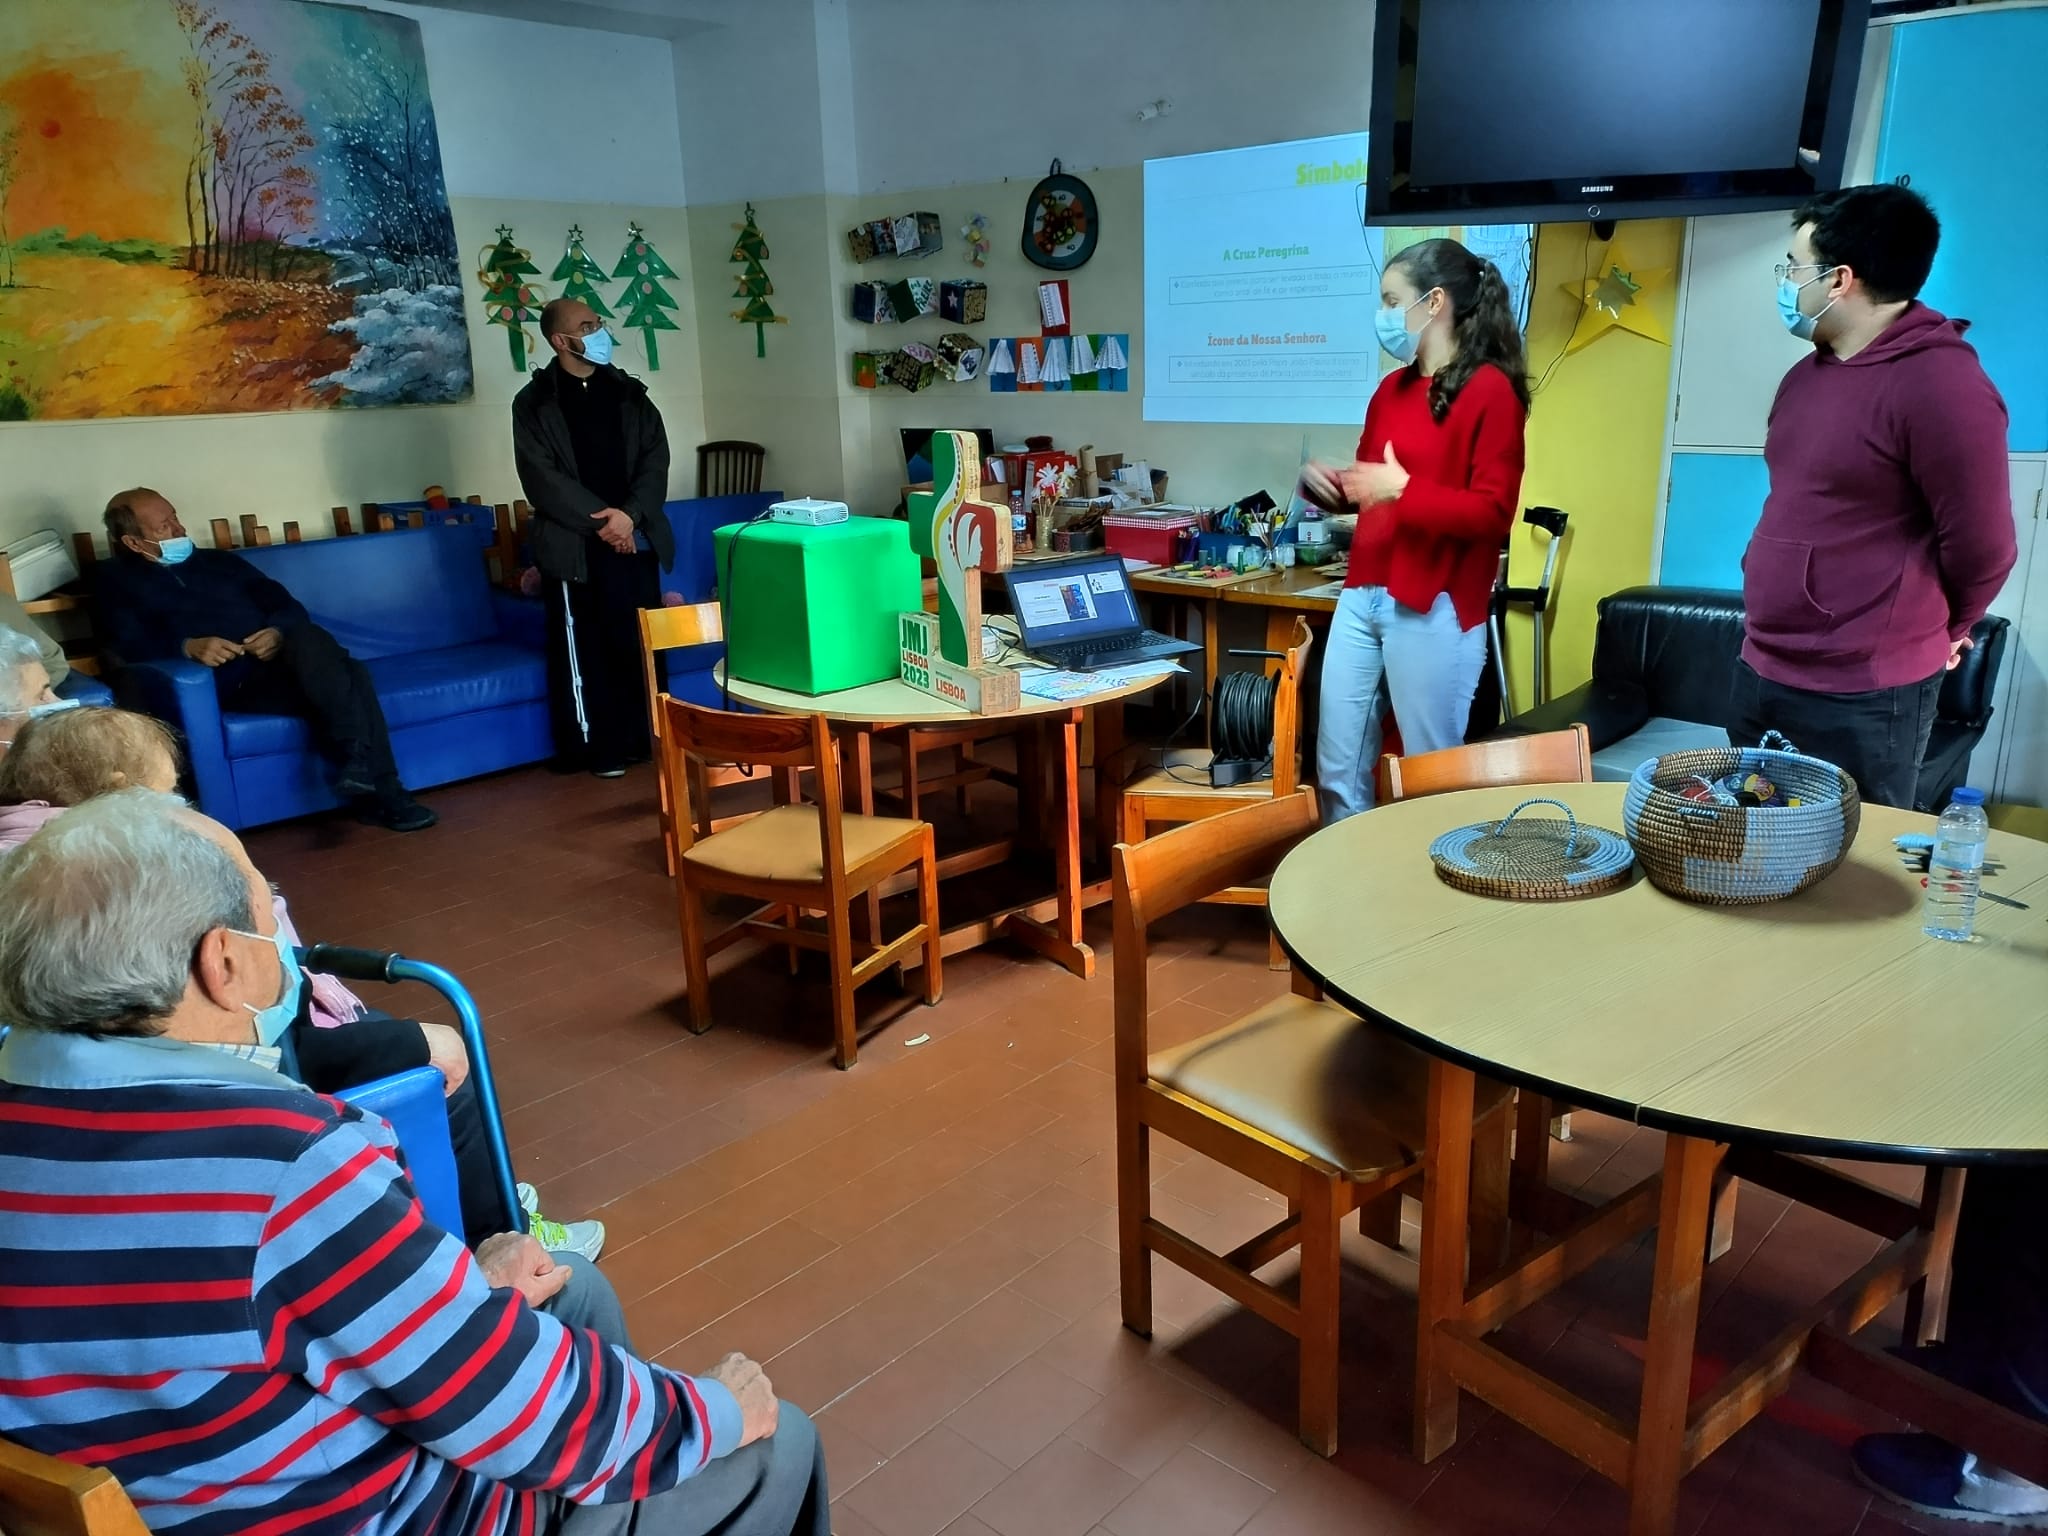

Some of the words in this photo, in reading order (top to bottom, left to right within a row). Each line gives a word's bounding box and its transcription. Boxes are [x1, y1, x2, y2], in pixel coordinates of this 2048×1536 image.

[1581, 185, 1614, 193] SAMSUNG
[1223, 249, 1231, 261] A
[1233, 248, 1256, 260] Cruz
[1258, 244, 1309, 260] Peregrina
[1236, 334, 1249, 345] da
[1251, 333, 1281, 345] Nossa
[1283, 332, 1327, 344] Senhora
[902, 618, 928, 656] JMJ
[902, 650, 929, 670] LISBOA
[902, 662, 930, 689] 2023
[935, 678, 967, 702] LISBOA
